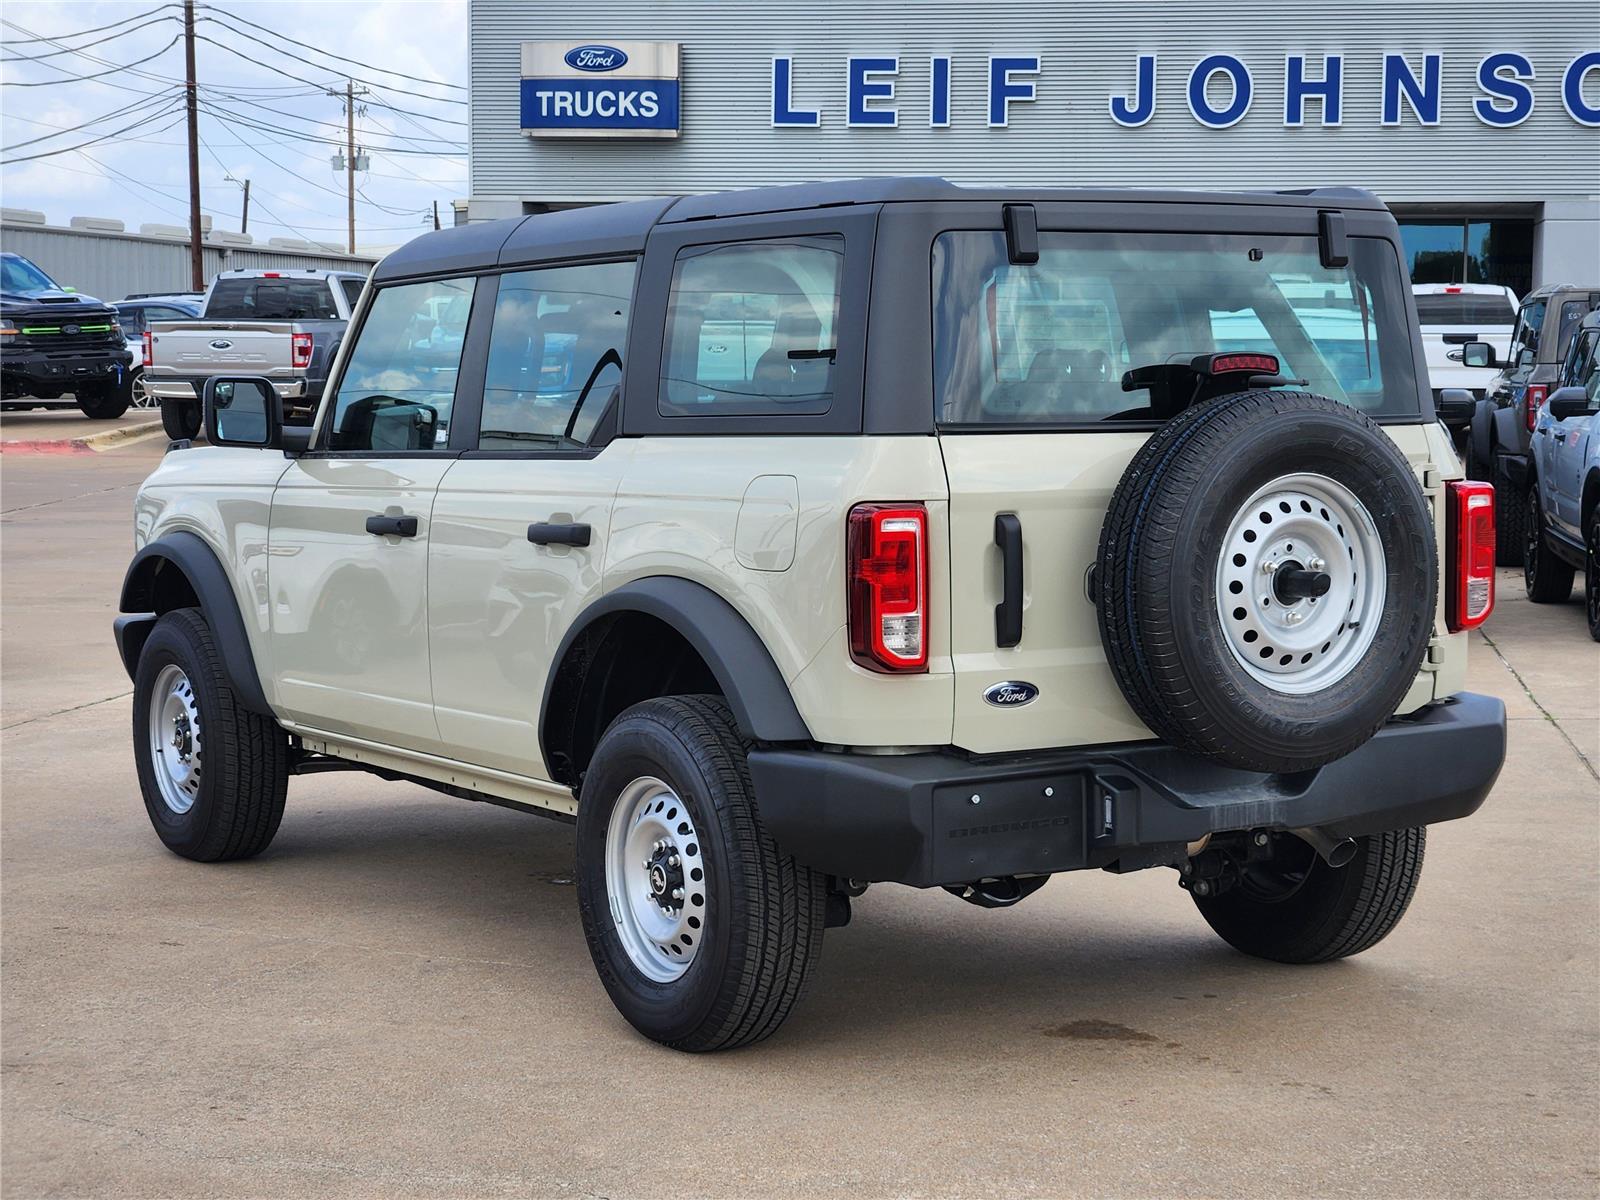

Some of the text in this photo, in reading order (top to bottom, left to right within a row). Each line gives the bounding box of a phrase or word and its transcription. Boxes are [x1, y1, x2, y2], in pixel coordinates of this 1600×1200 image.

[576, 49, 615, 67] Ford
[771, 50, 1600, 129] LEIF JOHNSO
[535, 90, 659, 118] TRUCKS
[997, 686, 1027, 702] Ford
